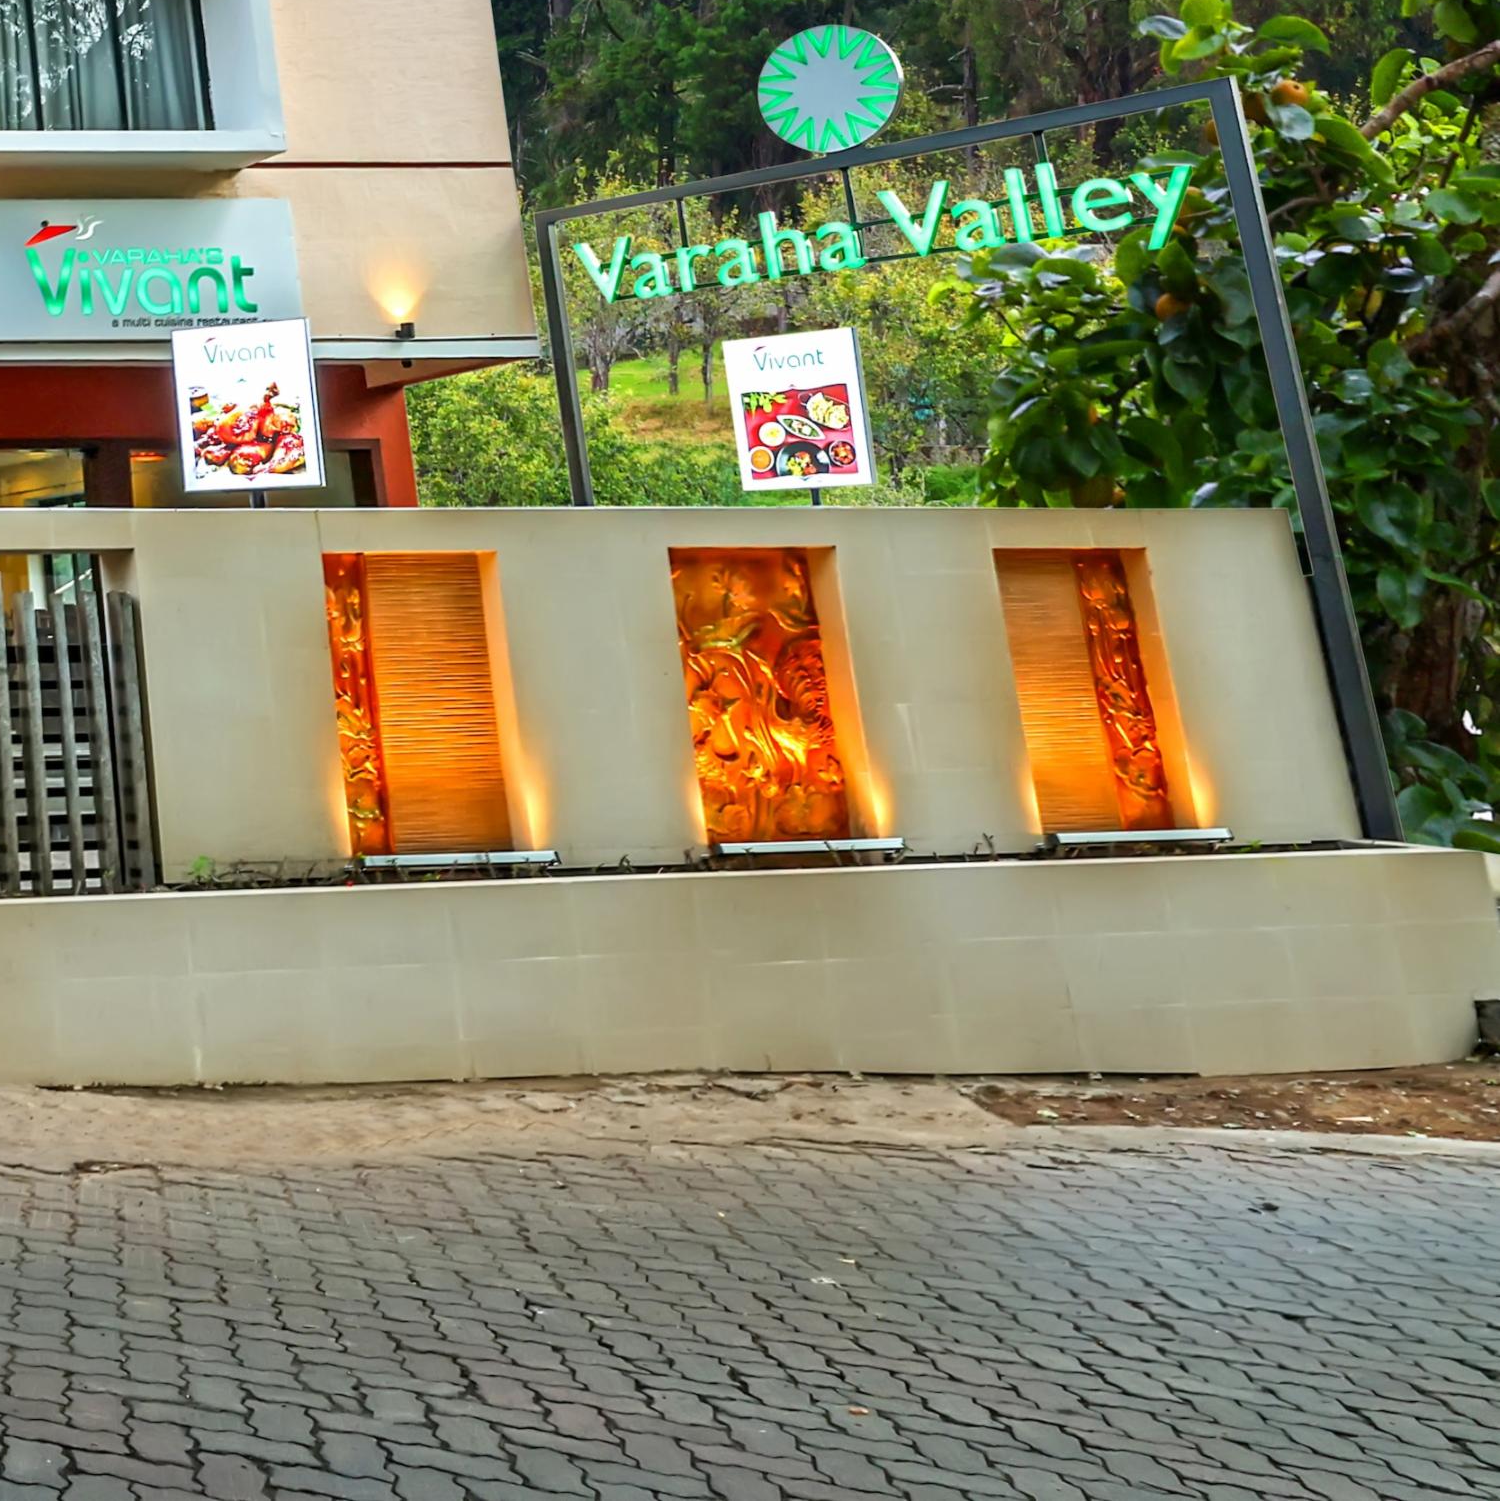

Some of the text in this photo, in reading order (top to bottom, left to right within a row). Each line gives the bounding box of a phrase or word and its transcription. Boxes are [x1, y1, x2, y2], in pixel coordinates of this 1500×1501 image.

[573, 161, 1193, 305] Varaha Valley
[92, 247, 224, 265] VARAHA'S
[24, 247, 258, 316] Vivant
[122, 317, 151, 328] multi
[154, 316, 194, 328] cuisine
[203, 342, 277, 364] Vivant
[752, 348, 825, 372] Vivant
